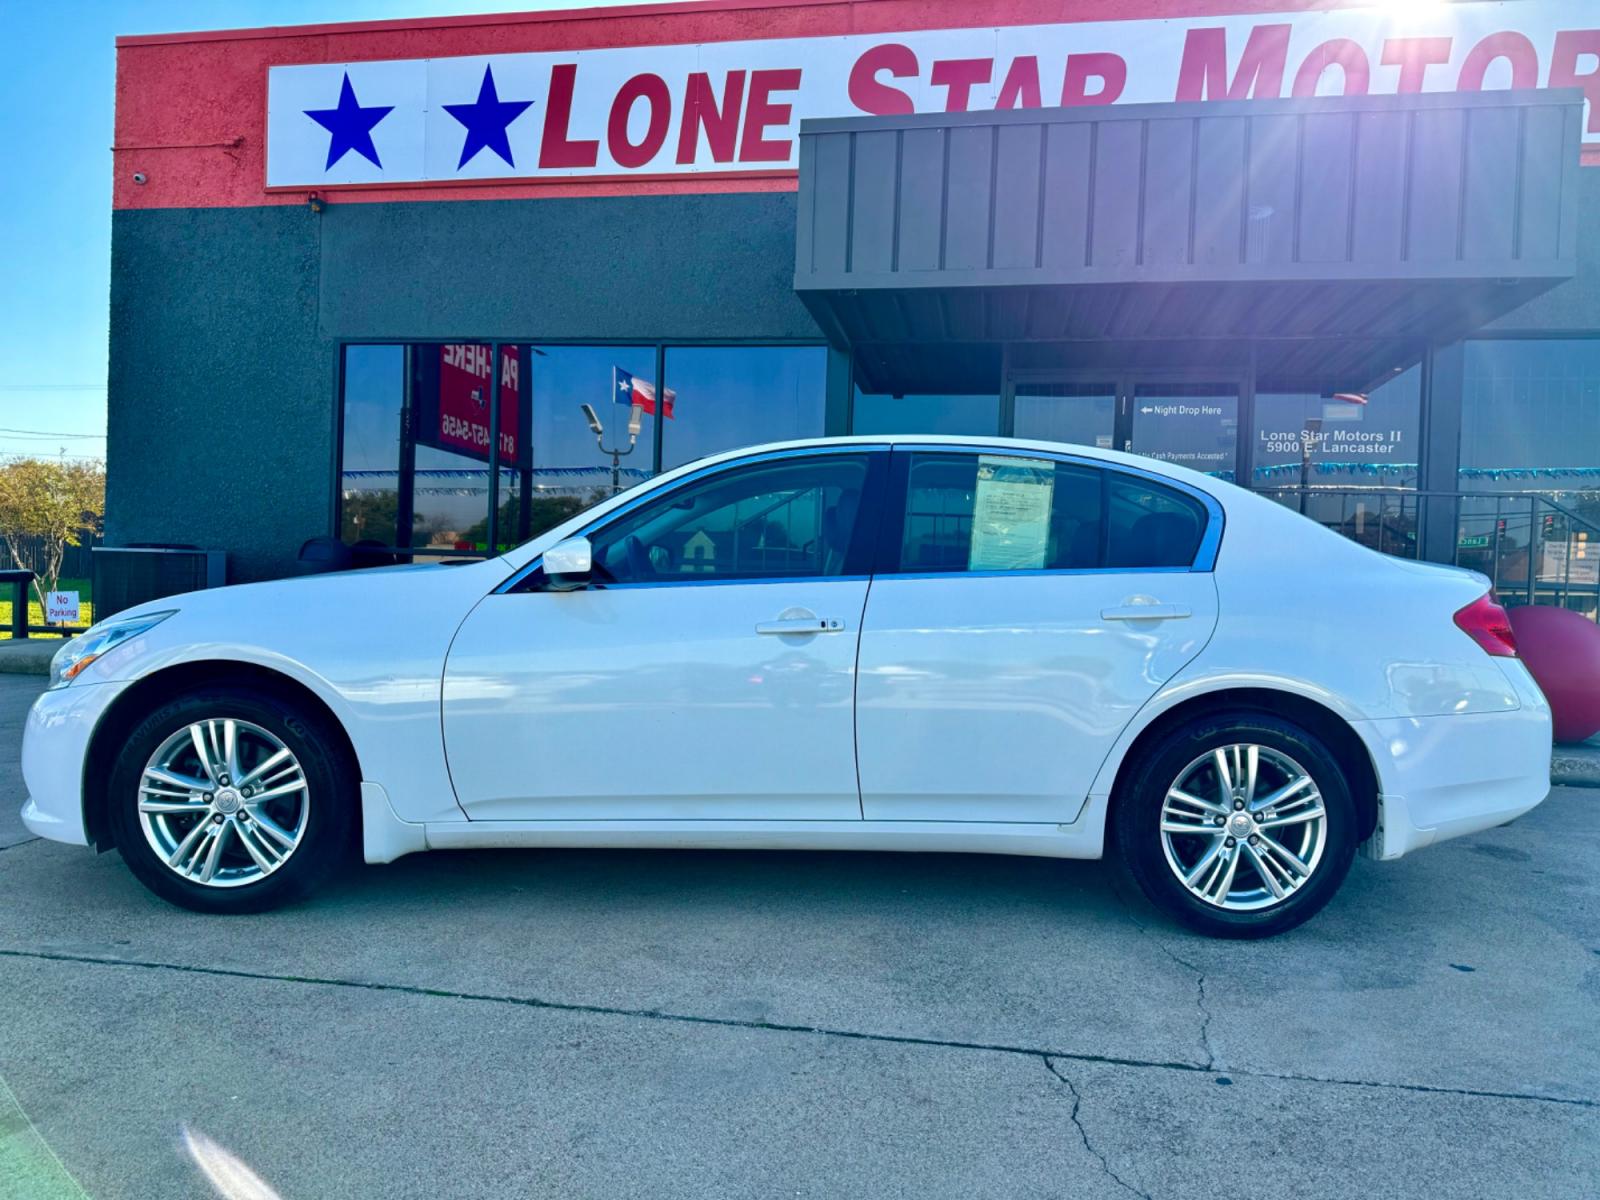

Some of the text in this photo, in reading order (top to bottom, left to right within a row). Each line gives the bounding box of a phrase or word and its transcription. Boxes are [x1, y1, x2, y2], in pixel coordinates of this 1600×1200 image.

[538, 63, 802, 169] LONE
[847, 43, 1128, 115] STAR
[1154, 406, 1222, 416] Night Drop Here
[1260, 430, 1402, 442] Lone Star Motors II
[1266, 441, 1394, 453] 5900 E. Lancaster
[56, 595, 68, 605] No
[49, 608, 77, 618] Parking
